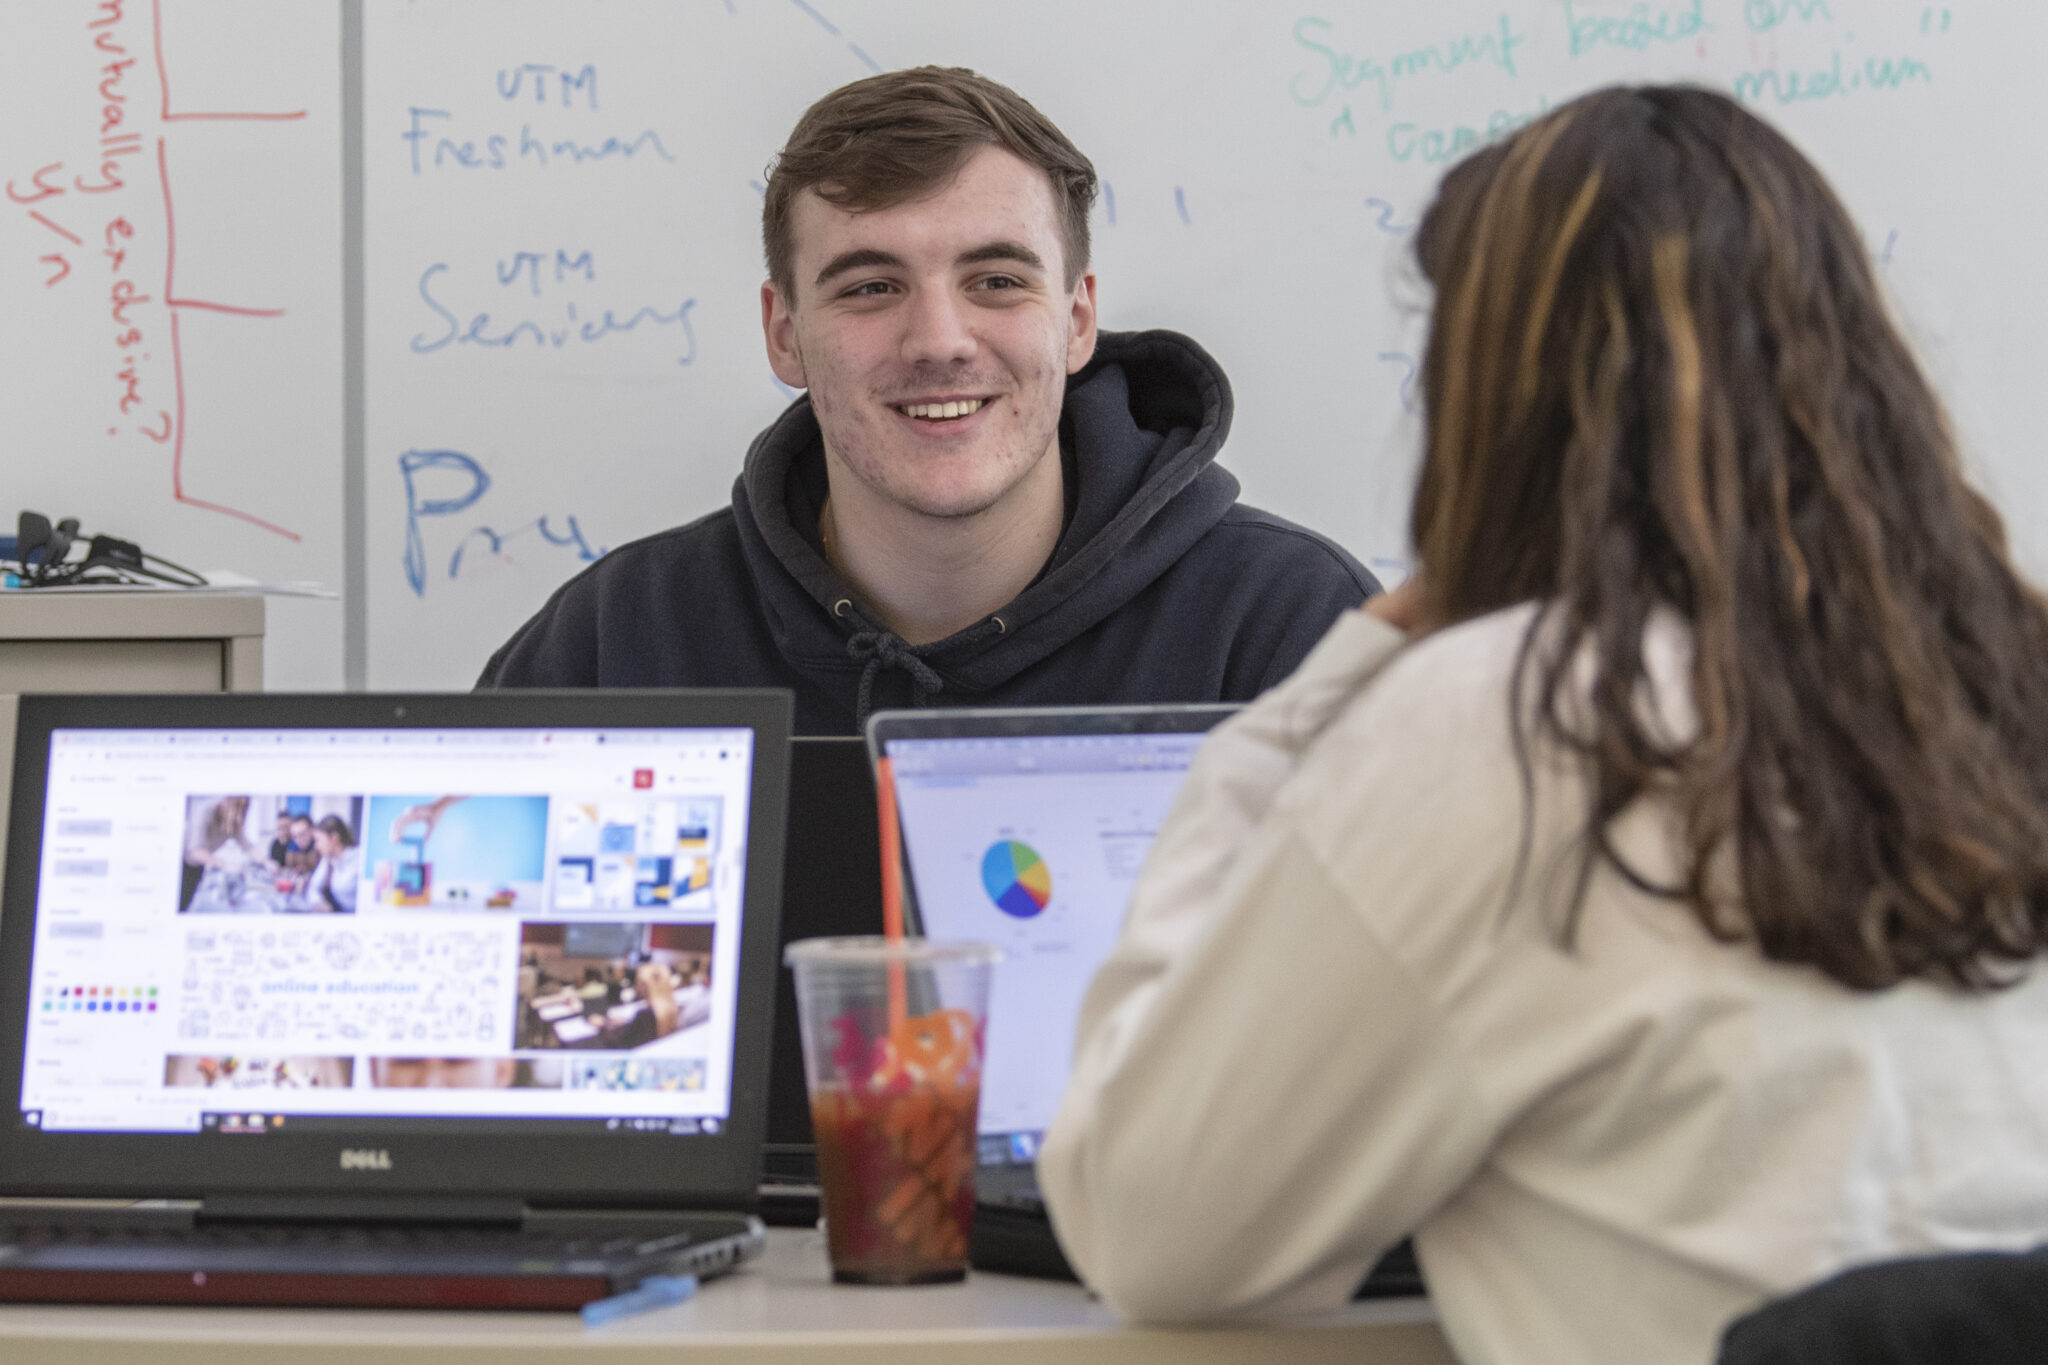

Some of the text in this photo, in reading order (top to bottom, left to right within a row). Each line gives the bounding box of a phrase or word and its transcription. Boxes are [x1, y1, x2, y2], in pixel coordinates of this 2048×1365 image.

[496, 62, 600, 110] UTM
[496, 249, 595, 297] UTM
[340, 1149, 393, 1170] DELL
